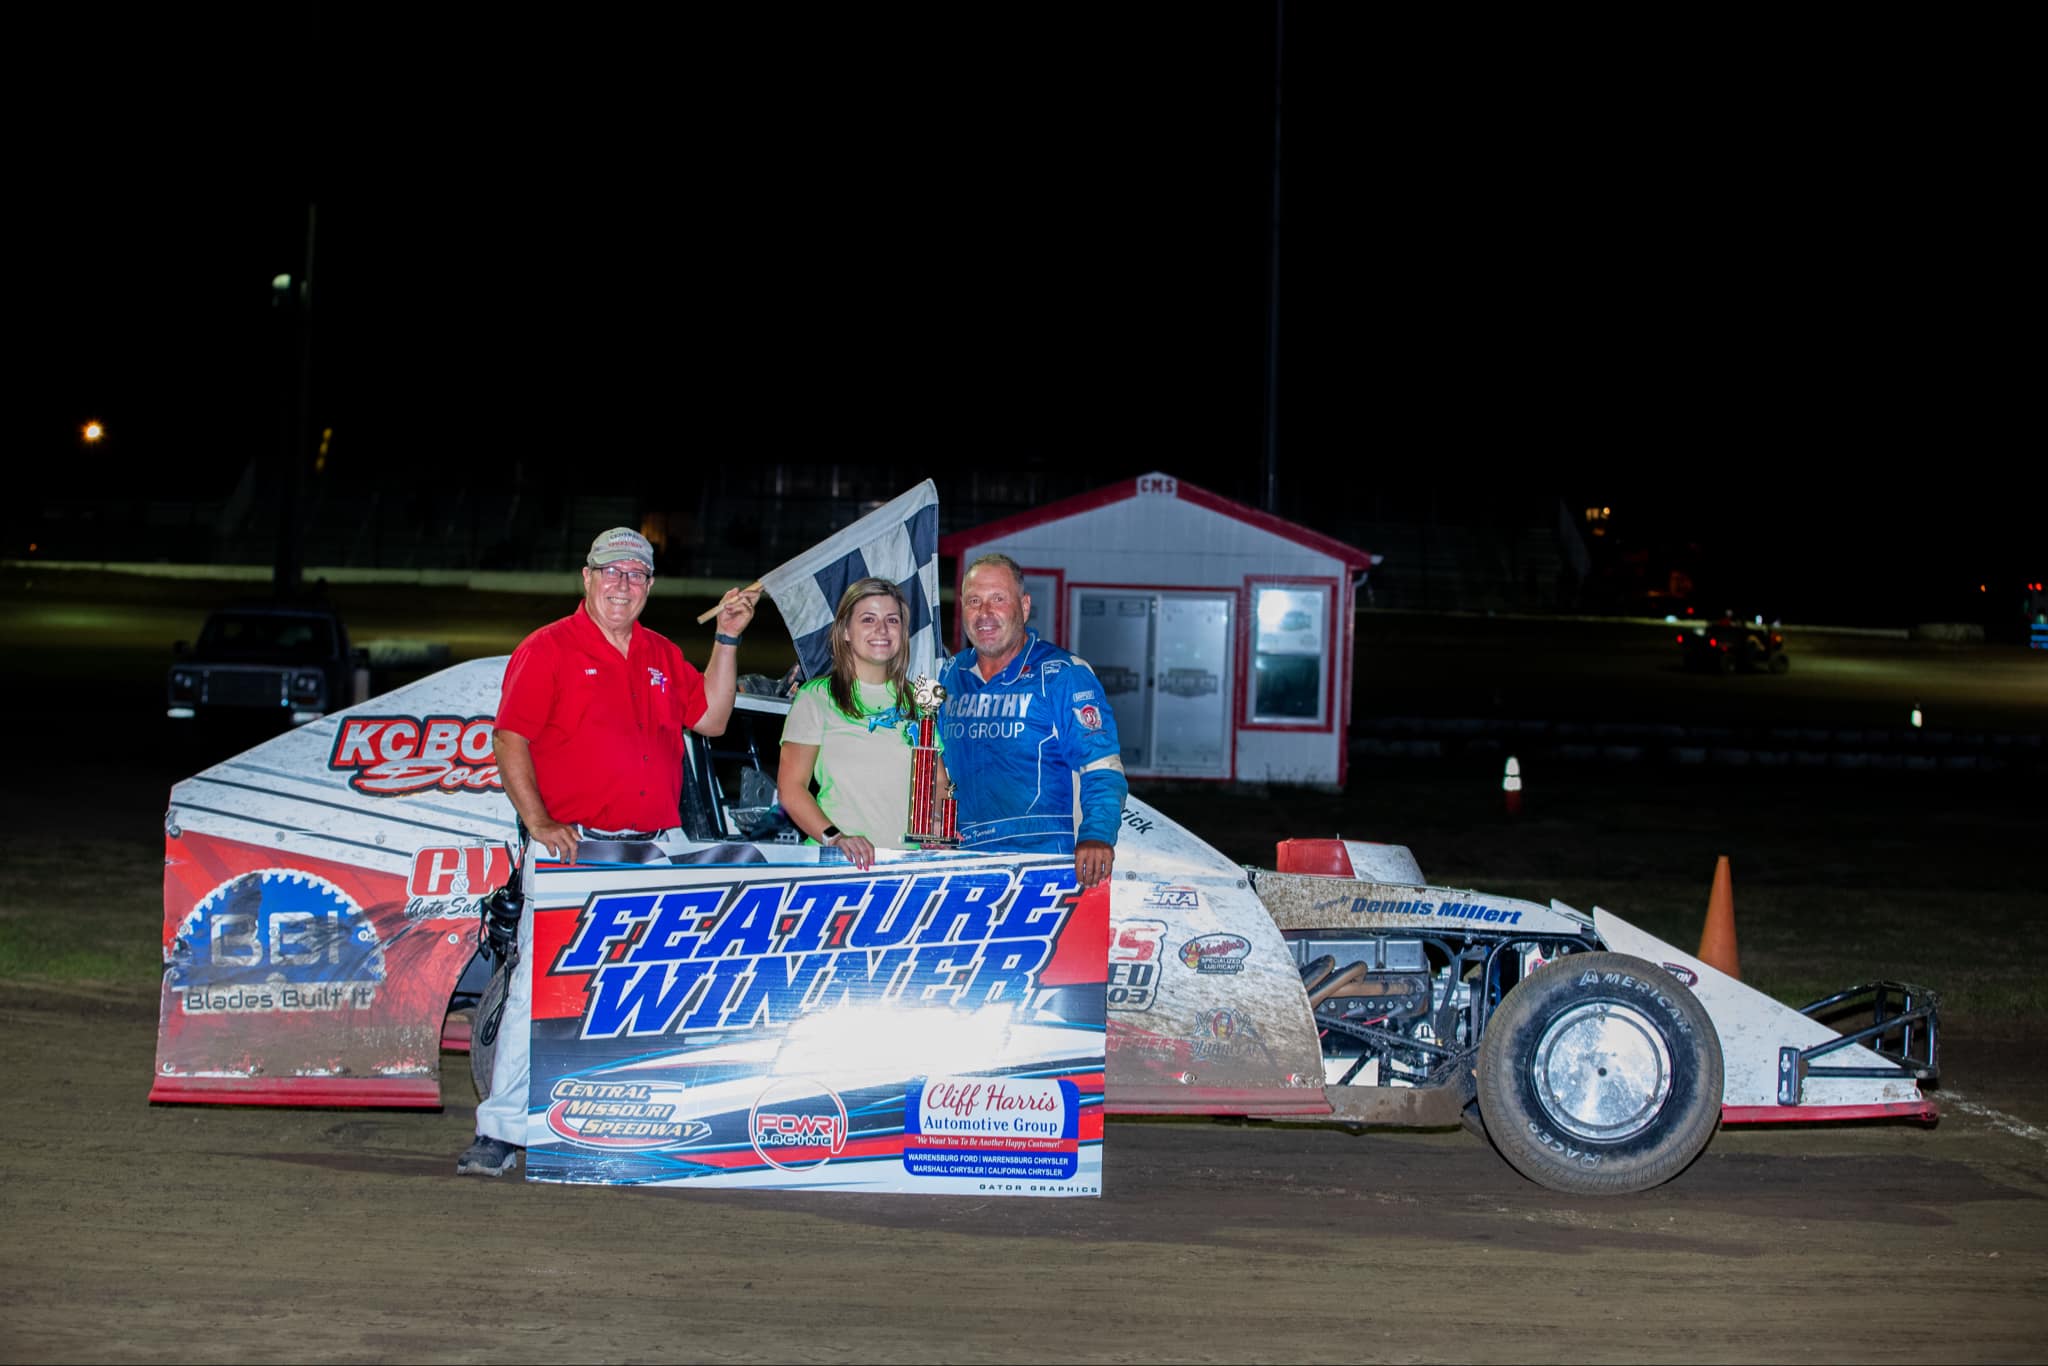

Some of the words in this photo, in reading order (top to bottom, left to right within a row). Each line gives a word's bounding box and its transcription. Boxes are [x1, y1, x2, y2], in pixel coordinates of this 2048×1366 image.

[1140, 479, 1174, 493] CMS
[943, 722, 965, 739] UTO
[968, 721, 1025, 739] GROUP
[338, 721, 417, 763] KC
[421, 721, 497, 762] BO
[1120, 808, 1154, 835] rick
[407, 897, 447, 917] Auto
[447, 897, 483, 917] Sal
[1350, 898, 1435, 916] Dennis
[1436, 901, 1523, 925] Millert
[557, 865, 1082, 972] FEATURE
[1108, 963, 1154, 987] ED
[579, 938, 1053, 1040] WINNER
[1108, 987, 1149, 1004] 03
[186, 990, 274, 1010] Blades
[282, 988, 343, 1008] Built
[1578, 968, 1692, 1033] AMERICAN
[554, 1081, 648, 1100] CENTRAL
[927, 1082, 982, 1117] Cliff
[984, 1083, 1058, 1112] Harris
[564, 1101, 673, 1118] MISSOURI
[581, 1119, 698, 1137] SPEEDWAY
[923, 1115, 1009, 1132] Automotive
[1013, 1118, 1058, 1138] Group
[757, 1134, 832, 1146] RACING
[929, 1136, 946, 1144] Want
[947, 1137, 959, 1145] You
[961, 1137, 969, 1145] To
[978, 1138, 1005, 1147] Another
[1005, 1138, 1026, 1150] Happy
[908, 1153, 959, 1163] WARRENSBURG
[960, 1154, 979, 1163] FORD
[982, 1155, 1033, 1165] WARRENSBURG
[1033, 1156, 1069, 1166] CHRYSLER
[913, 1164, 949, 1173] MARSHALL
[949, 1165, 985, 1175] CHRYSLER
[988, 1166, 1027, 1176] CALIFORNIA
[1028, 1167, 1063, 1177] CHRYSLER
[979, 1184, 1023, 1192] GATOR
[1030, 1185, 1098, 1193] GRAPHICS
